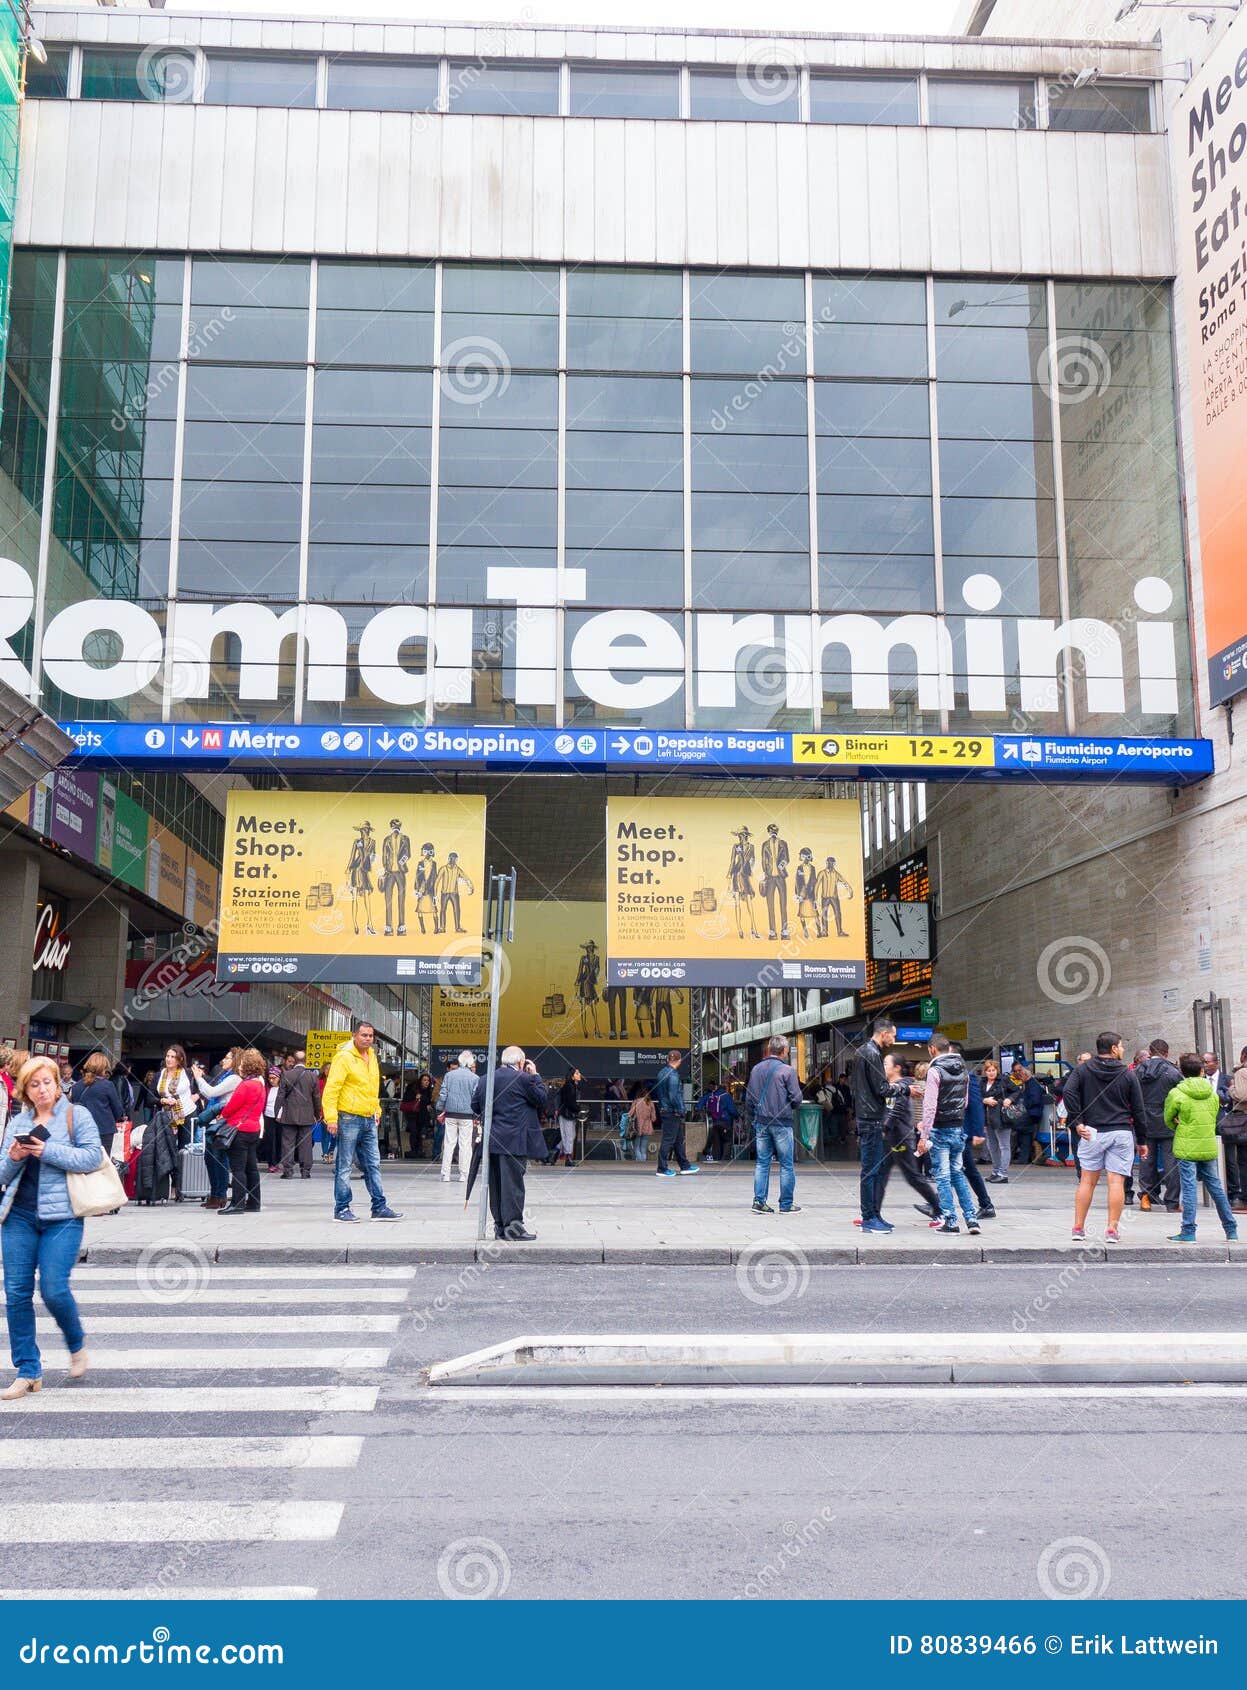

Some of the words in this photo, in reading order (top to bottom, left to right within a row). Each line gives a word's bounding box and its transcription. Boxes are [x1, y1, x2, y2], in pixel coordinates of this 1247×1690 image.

[1201, 299, 1236, 345] Roma
[228, 730, 300, 749] Metro
[424, 732, 535, 756] Shopping
[658, 736, 724, 750] Deposito
[728, 737, 784, 752] Bagagli
[846, 740, 888, 750] Binari
[674, 751, 706, 760] Luggage
[846, 752, 879, 760] Platforms
[1046, 742, 1114, 755] Fiumicino
[1117, 744, 1193, 758] Aeroporto
[1082, 757, 1108, 765] Airport
[236, 816, 304, 834] Meet.
[617, 822, 684, 840] Meet.
[235, 836, 302, 862] Shop.
[618, 843, 684, 867] Shop.
[234, 861, 278, 879] Eat.
[618, 867, 660, 884] Eat.
[232, 886, 300, 898] Stazione
[618, 892, 684, 904] Stazione
[264, 900, 300, 908] Termini
[440, 988, 492, 999] Stazion
